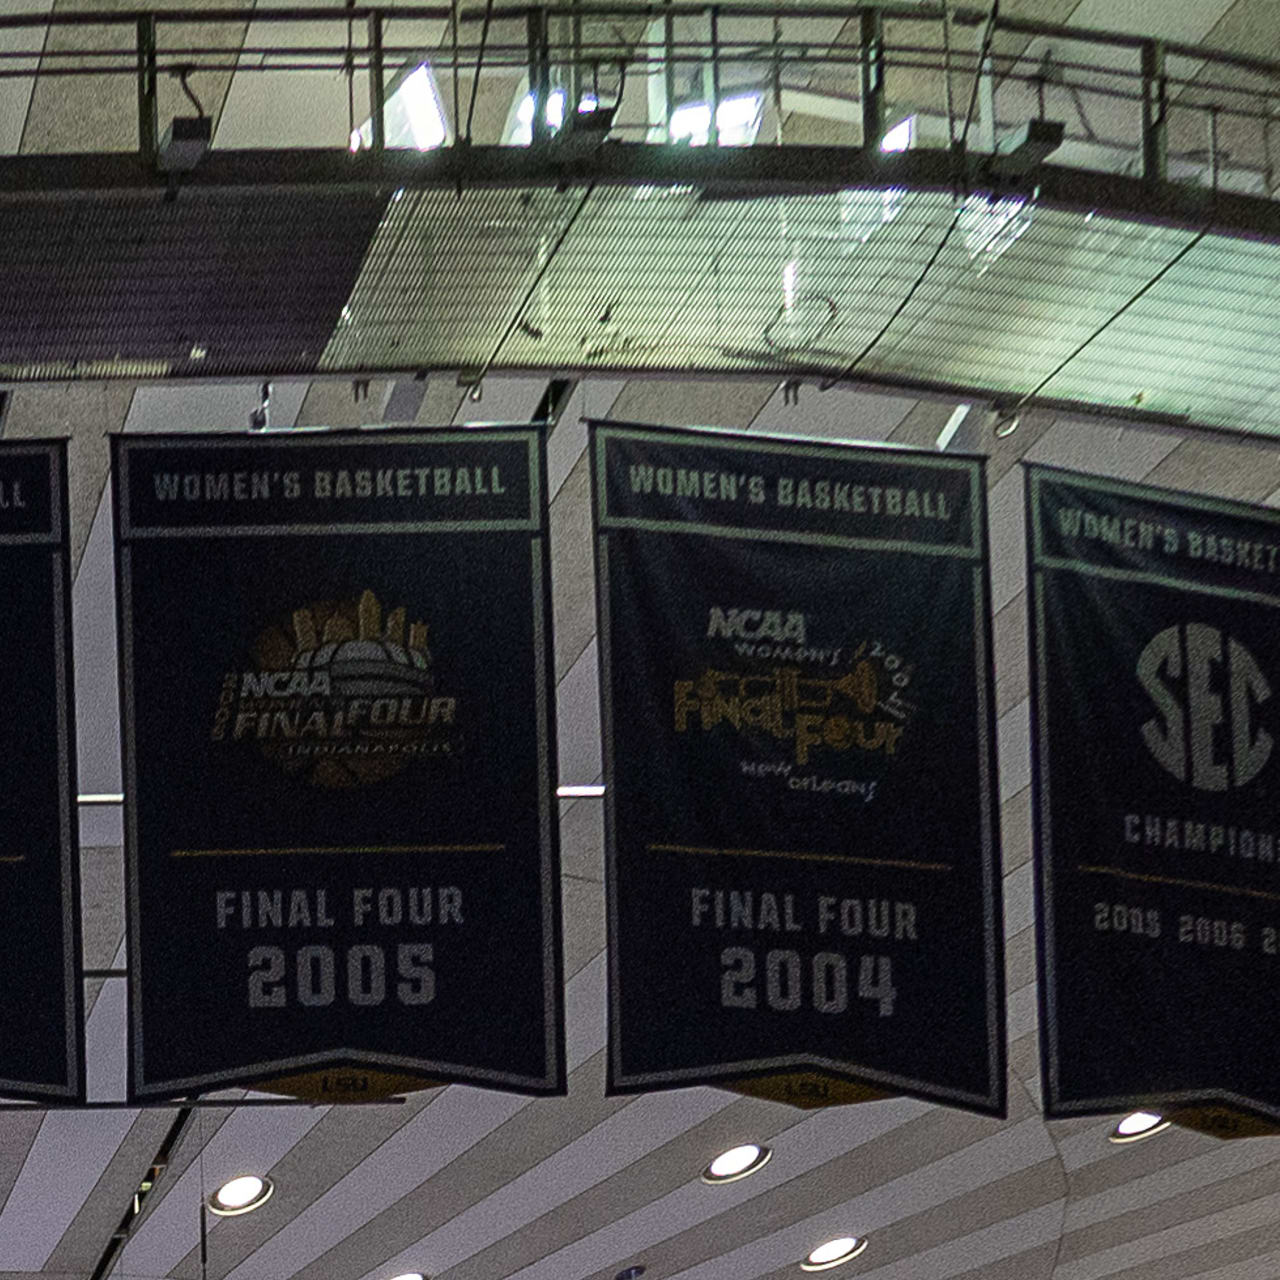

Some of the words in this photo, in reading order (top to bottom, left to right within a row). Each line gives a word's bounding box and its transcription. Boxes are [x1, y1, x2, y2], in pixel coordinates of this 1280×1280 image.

[154, 469, 301, 501] WOMEN'S
[314, 465, 506, 498] BASKETBALL
[630, 464, 766, 505] WOMEN'S
[778, 477, 951, 520] BASKETBALL
[1059, 507, 1180, 554] WOMEN'S
[707, 607, 806, 644] NCAA
[241, 672, 331, 697] NCAA
[1137, 622, 1274, 792] SEC
[1124, 814, 1280, 863] CHAMPION
[216, 889, 335, 928] FINAL
[353, 886, 465, 926] FOUR
[691, 888, 802, 932] FINAL
[817, 897, 918, 940] FOUR
[247, 944, 436, 1008] 2005
[720, 947, 896, 1018] 2004
